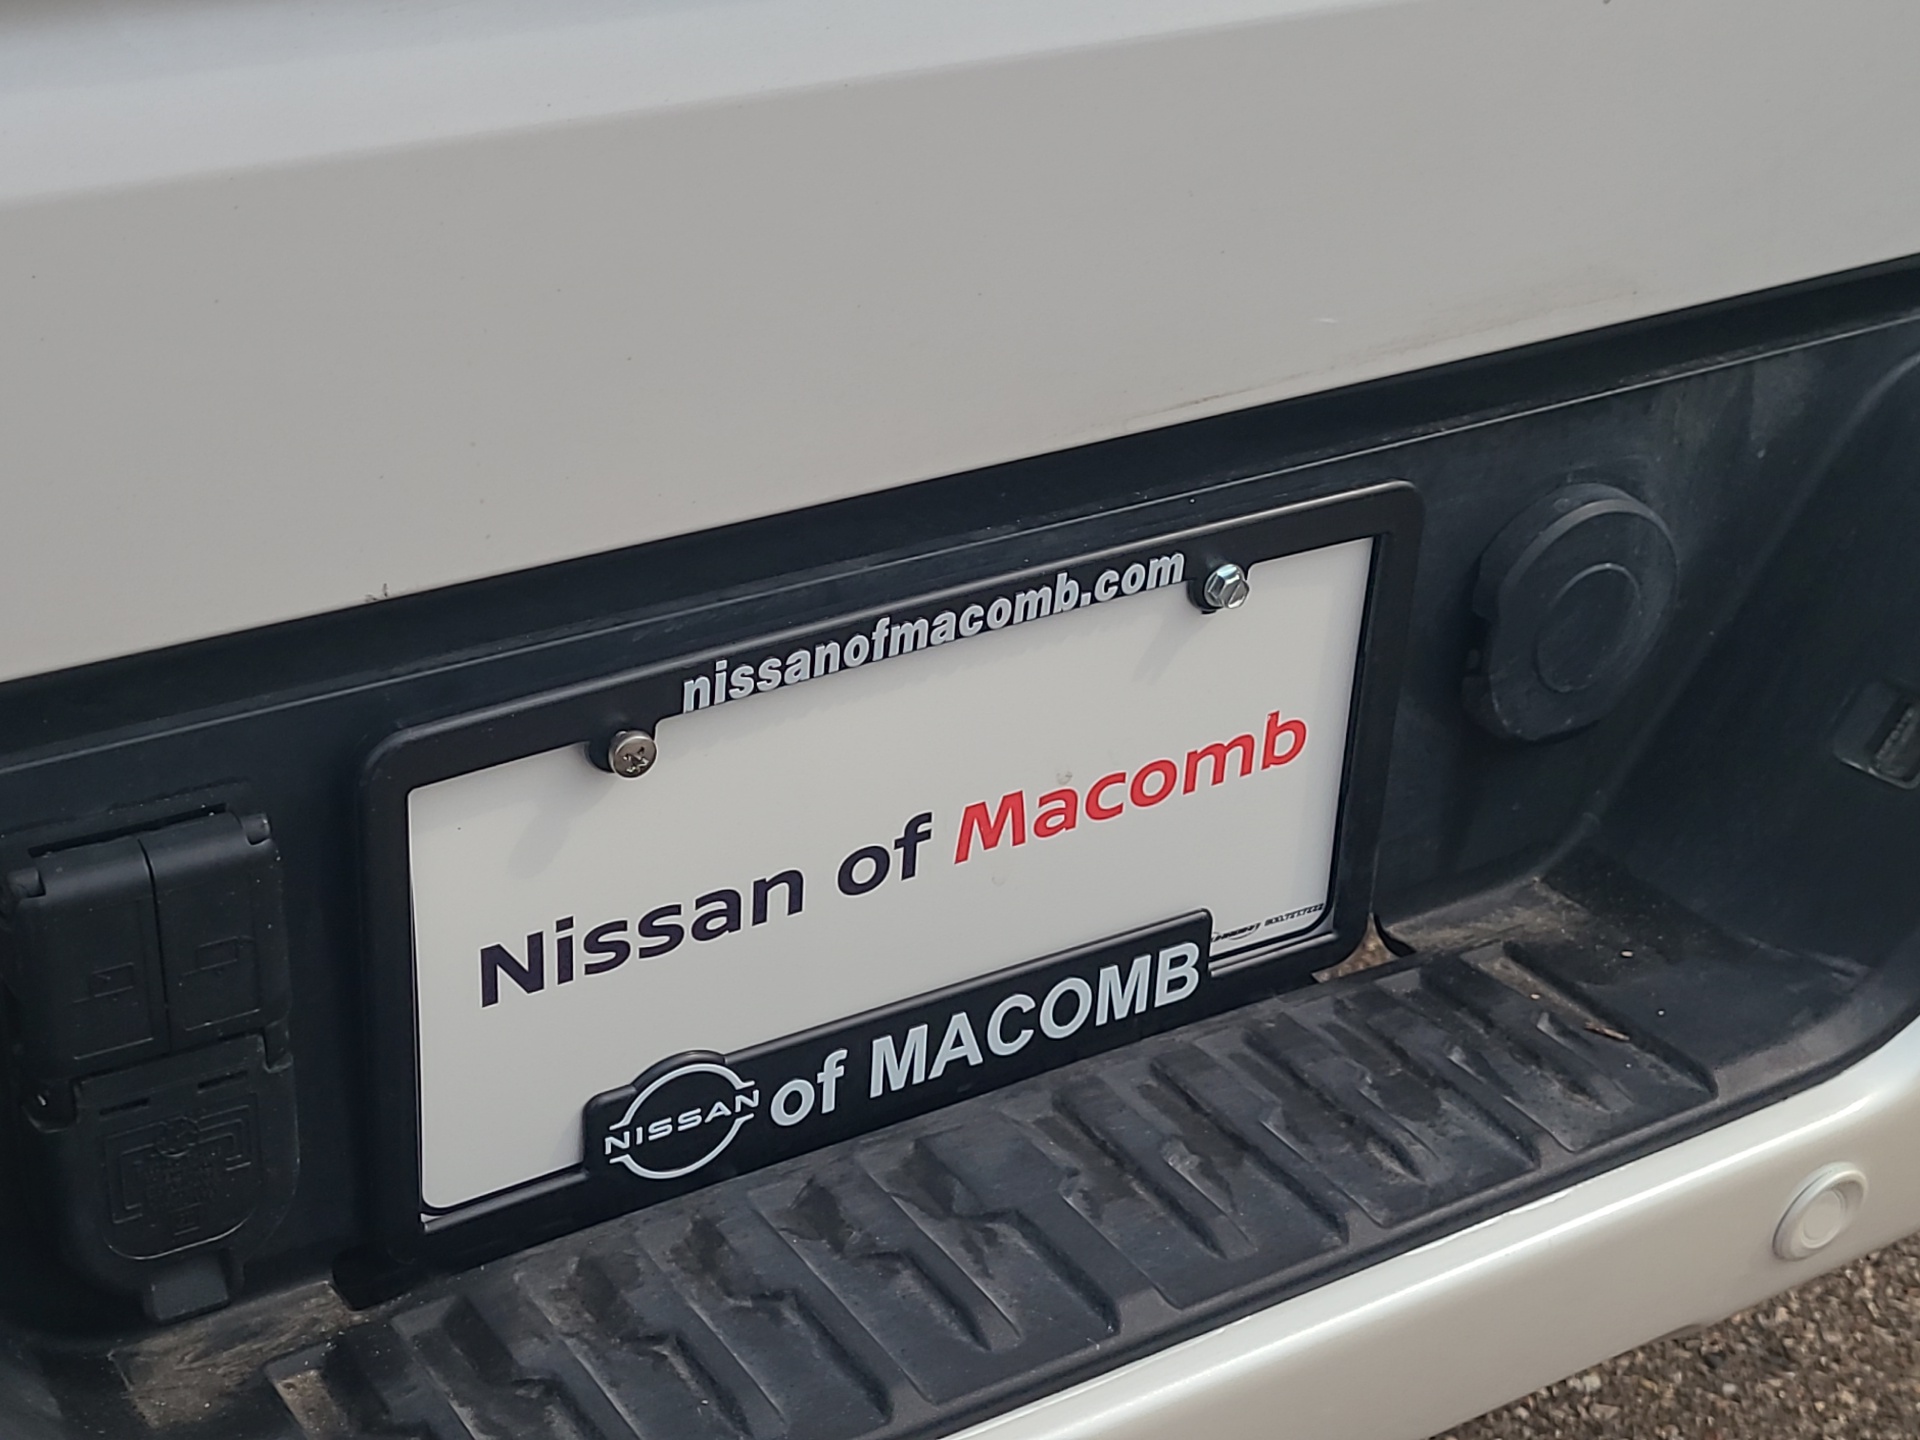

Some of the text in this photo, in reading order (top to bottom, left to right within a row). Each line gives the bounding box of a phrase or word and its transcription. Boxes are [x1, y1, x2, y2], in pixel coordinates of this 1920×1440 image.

[683, 551, 1186, 714] nissanofmacomb.com
[480, 710, 1307, 1008] Nissan of Macomb
[604, 941, 1201, 1155] NISSAN of MACOMB
